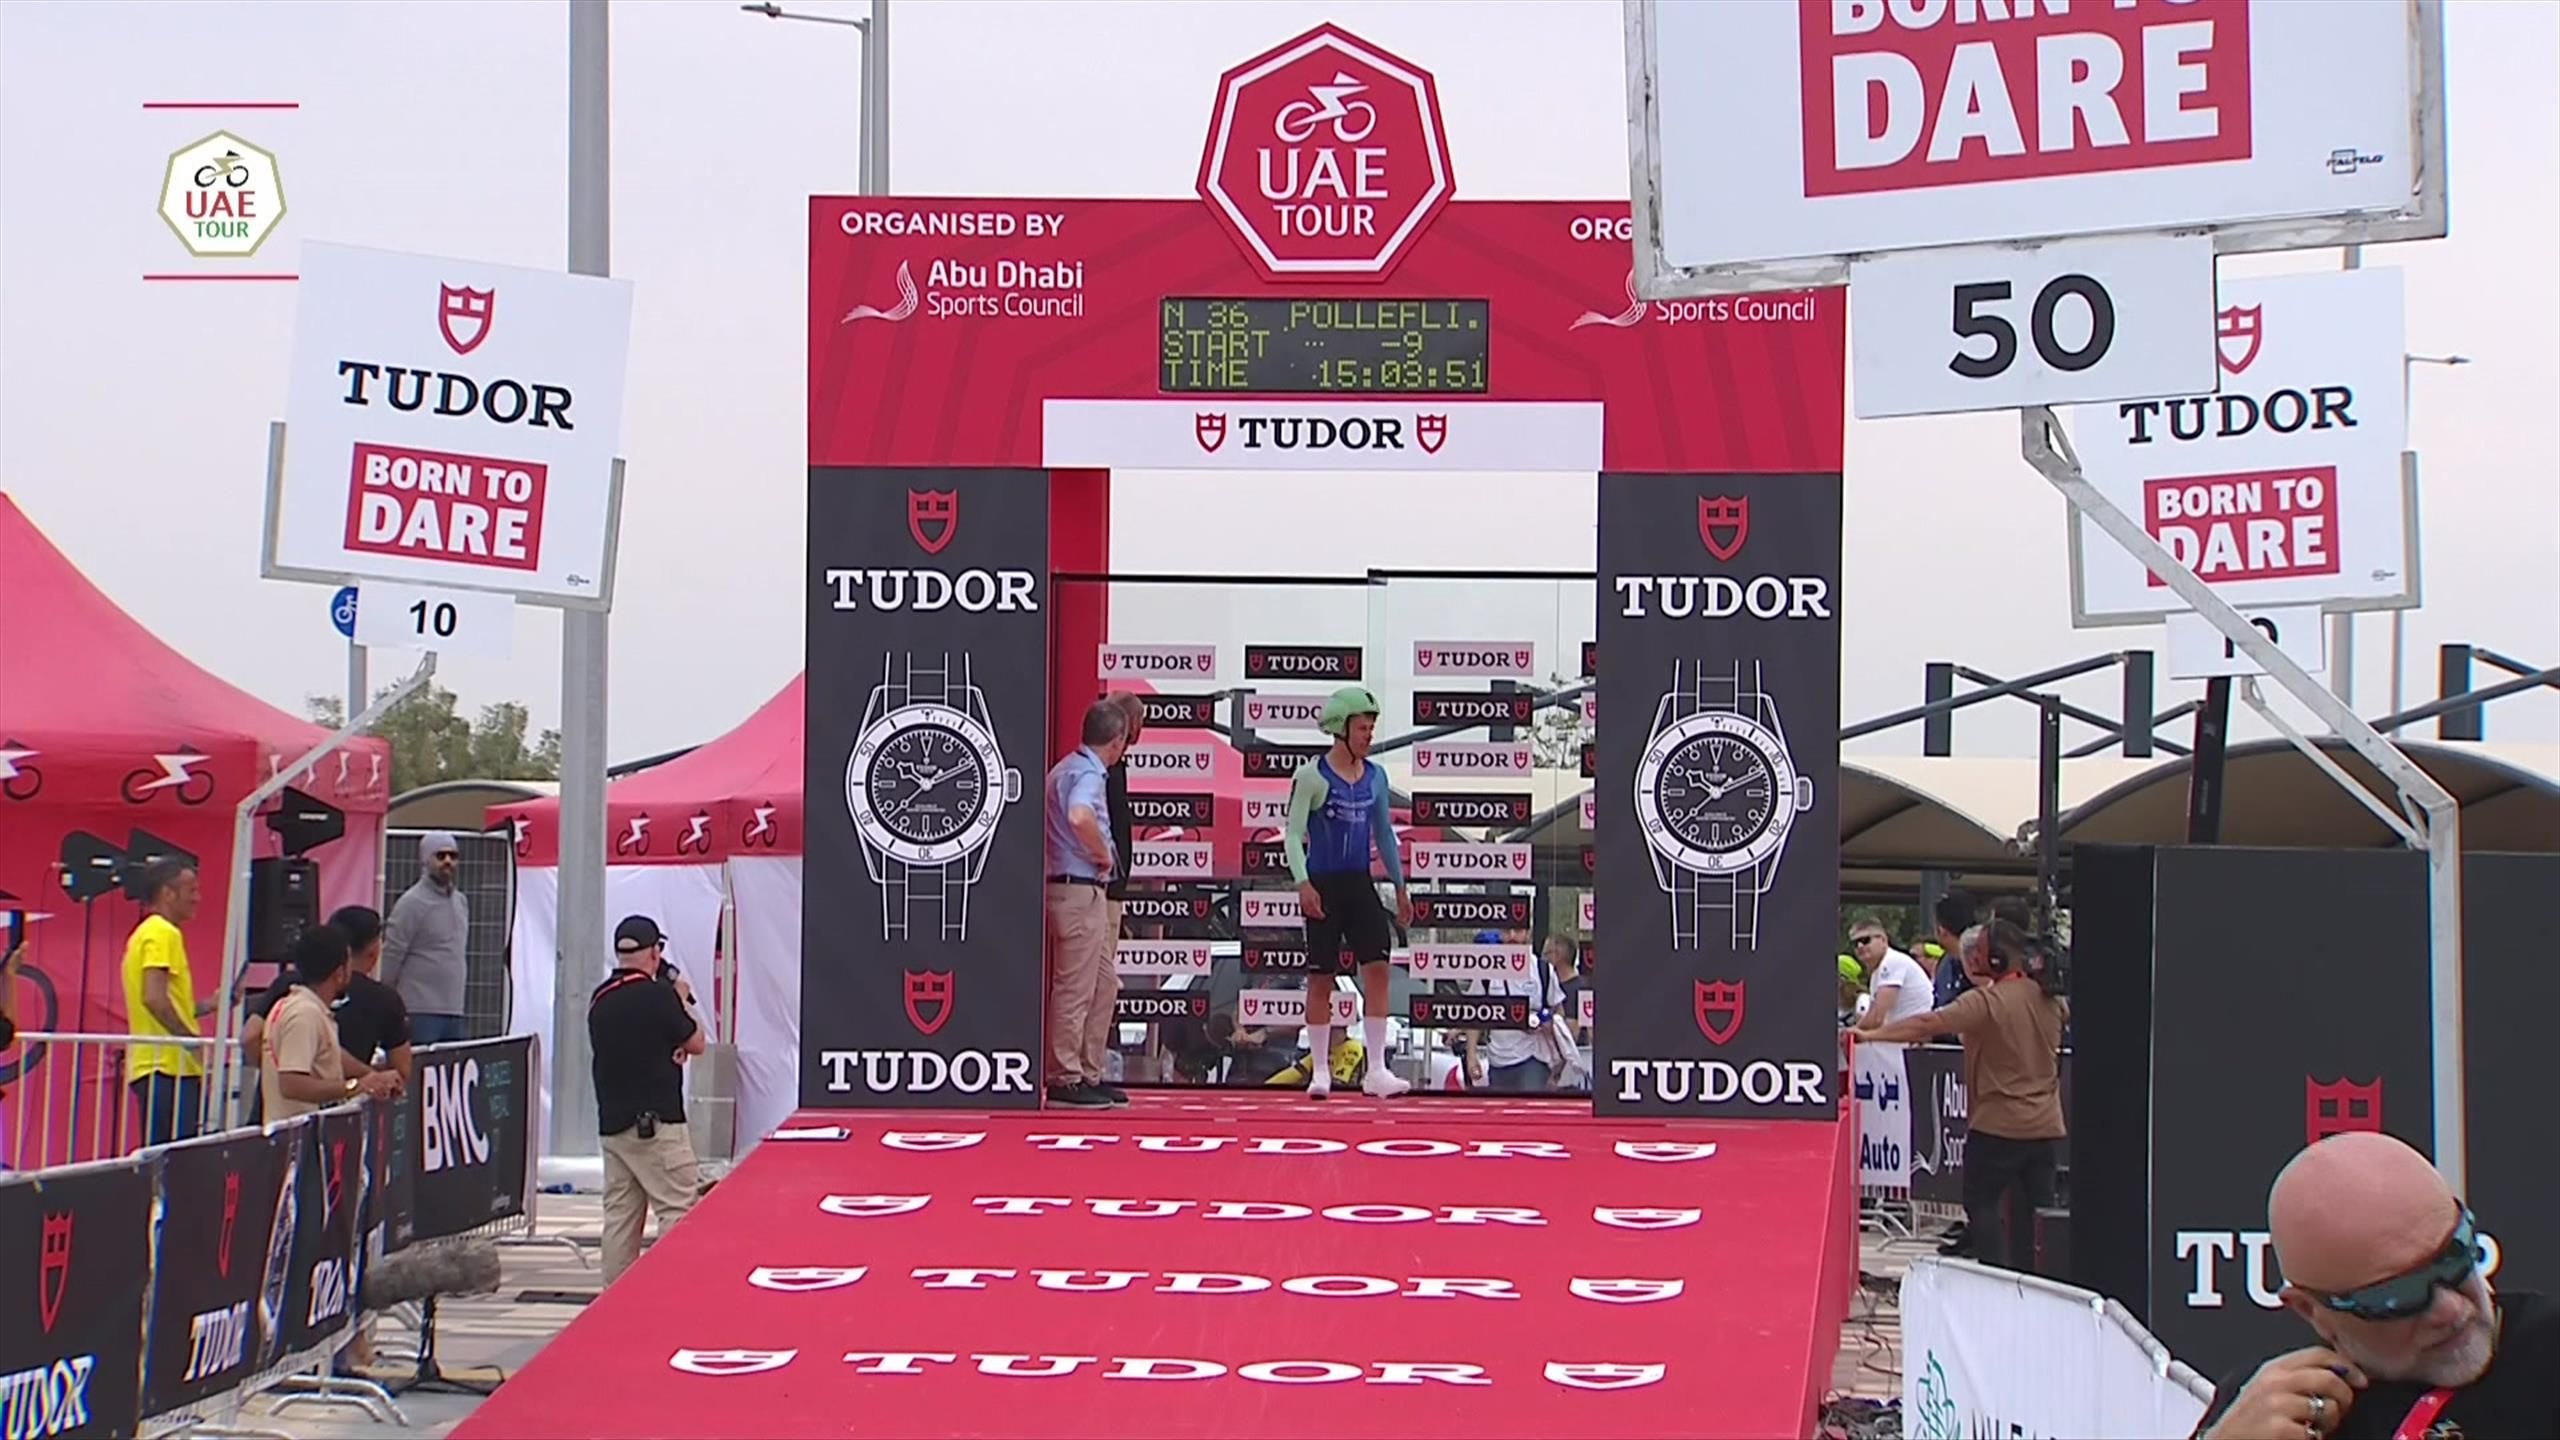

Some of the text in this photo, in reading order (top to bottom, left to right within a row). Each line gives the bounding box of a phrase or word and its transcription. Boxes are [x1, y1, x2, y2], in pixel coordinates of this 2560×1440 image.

[1832, 20, 2219, 171] DARE
[1258, 148, 1388, 200] UAE
[841, 211, 1065, 237] ORGANISED BY
[1273, 204, 1375, 236] TOUR
[927, 259, 1083, 289] Abu Dhabi
[926, 291, 1083, 320] Sports Council
[1164, 302, 1184, 328] N
[1208, 302, 1249, 328] 36
[1656, 296, 1815, 326] Sports Council
[1948, 273, 2115, 378] 50
[1164, 330, 1423, 357] START -9
[1164, 359, 1485, 387] TIME 15:03:51
[338, 360, 574, 431] TUDOR
[2120, 386, 2358, 444] TUDOR
[1238, 417, 1405, 450] TUDOR
[363, 453, 533, 503] BORN TO
[2157, 476, 2324, 520] BORN TO
[357, 491, 530, 560] DARE
[2158, 515, 2327, 573] DARE
[826, 569, 1038, 611] TUDOR
[1615, 576, 1831, 618] TUDOR
[410, 600, 457, 637] 10
[1121, 655, 1192, 670] TUDOR
[1268, 655, 1340, 672] TUDOR
[1437, 651, 1510, 667] TUDOR
[1436, 701, 1510, 718] TUDOR
[1435, 752, 1509, 768] TUDOR
[1128, 802, 1191, 818] UDOR
[1435, 802, 1509, 818] TUDOR
[1133, 852, 1189, 867] UDOR
[1434, 853, 1508, 869] TUDOR
[1433, 903, 1508, 920] TUDOR
[1117, 951, 1188, 966] TUDOR
[1433, 954, 1507, 970] TUDOR
[1116, 999, 1188, 1015] TUDOR
[1432, 1004, 1506, 1021] TUDOR
[821, 1050, 1034, 1092] TUDOR
[1611, 1060, 1827, 1103] TUDOR
[1943, 1071, 1968, 1118] Abu
[422, 1058, 490, 1172] BMC
[1025, 1134, 1571, 1158] TUDOR
[1860, 1132, 1901, 1171] Auto
[971, 1196, 1548, 1226] TUDOR
[909, 1267, 1522, 1299] TUDOR
[842, 1351, 1493, 1386] TUDOR
